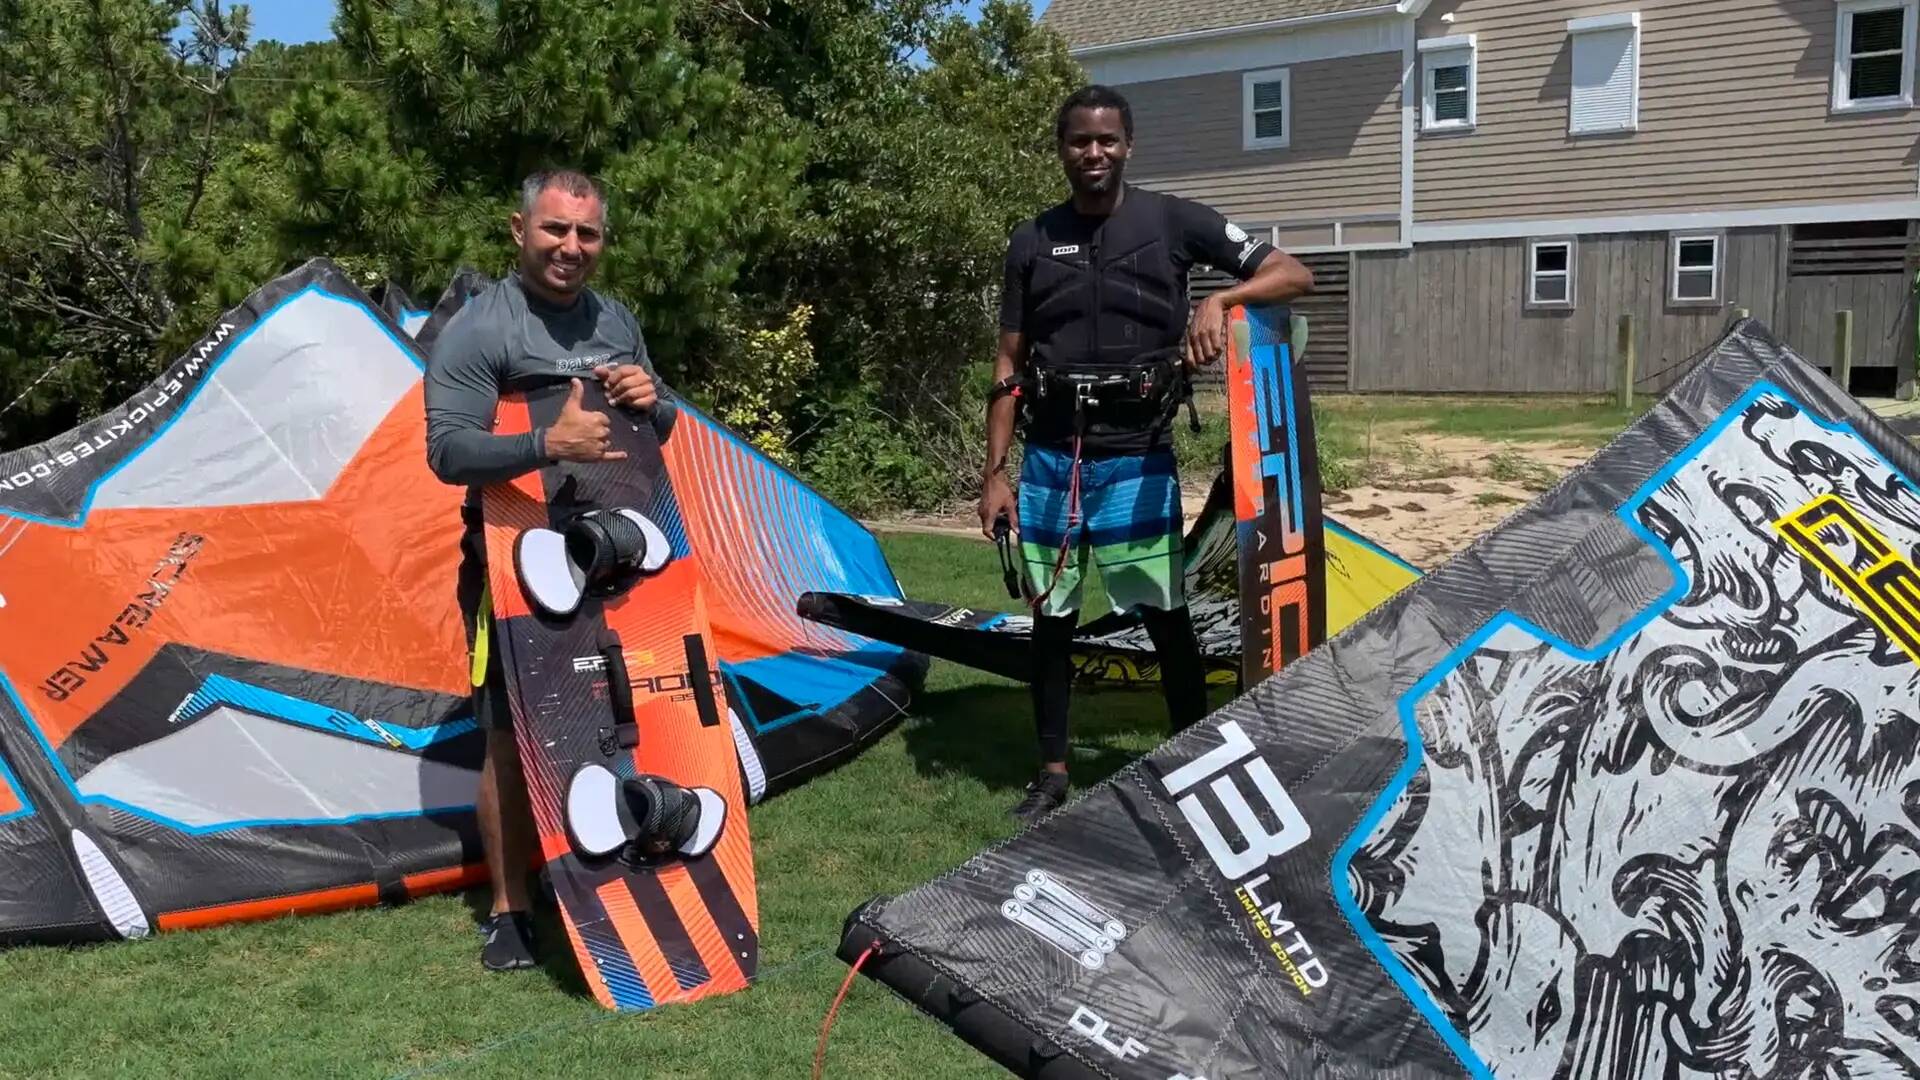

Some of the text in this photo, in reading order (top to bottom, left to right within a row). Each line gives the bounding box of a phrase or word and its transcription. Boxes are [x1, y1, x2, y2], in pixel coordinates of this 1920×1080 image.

[38, 531, 204, 702] SCREAMER
[1161, 719, 1312, 880] 13
[1234, 886, 1312, 996] LIMITED EDITION
[1243, 873, 1329, 988] LMTD
